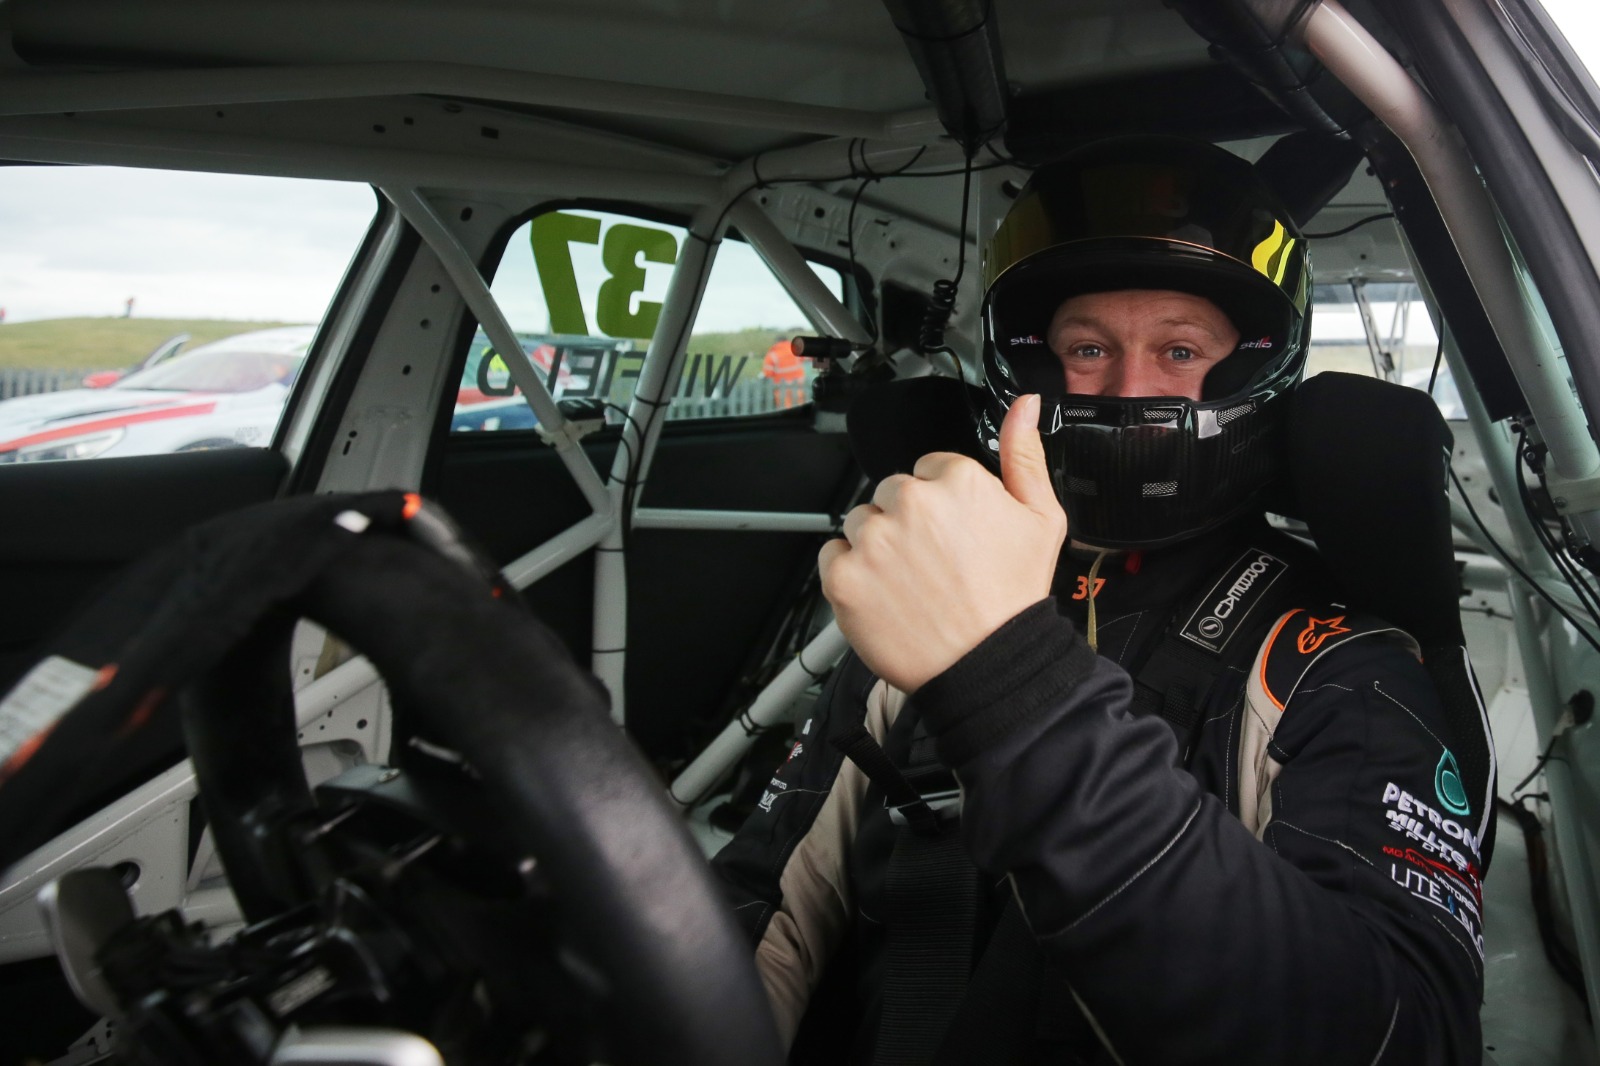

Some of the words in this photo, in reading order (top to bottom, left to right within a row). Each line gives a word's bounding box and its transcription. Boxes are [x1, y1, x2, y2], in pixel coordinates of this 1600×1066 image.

[1238, 337, 1273, 350] stilo
[1071, 575, 1107, 600] 37
[1213, 554, 1273, 619] CORBEAU
[1382, 782, 1481, 864] PETRON
[1391, 863, 1443, 904] LITE
